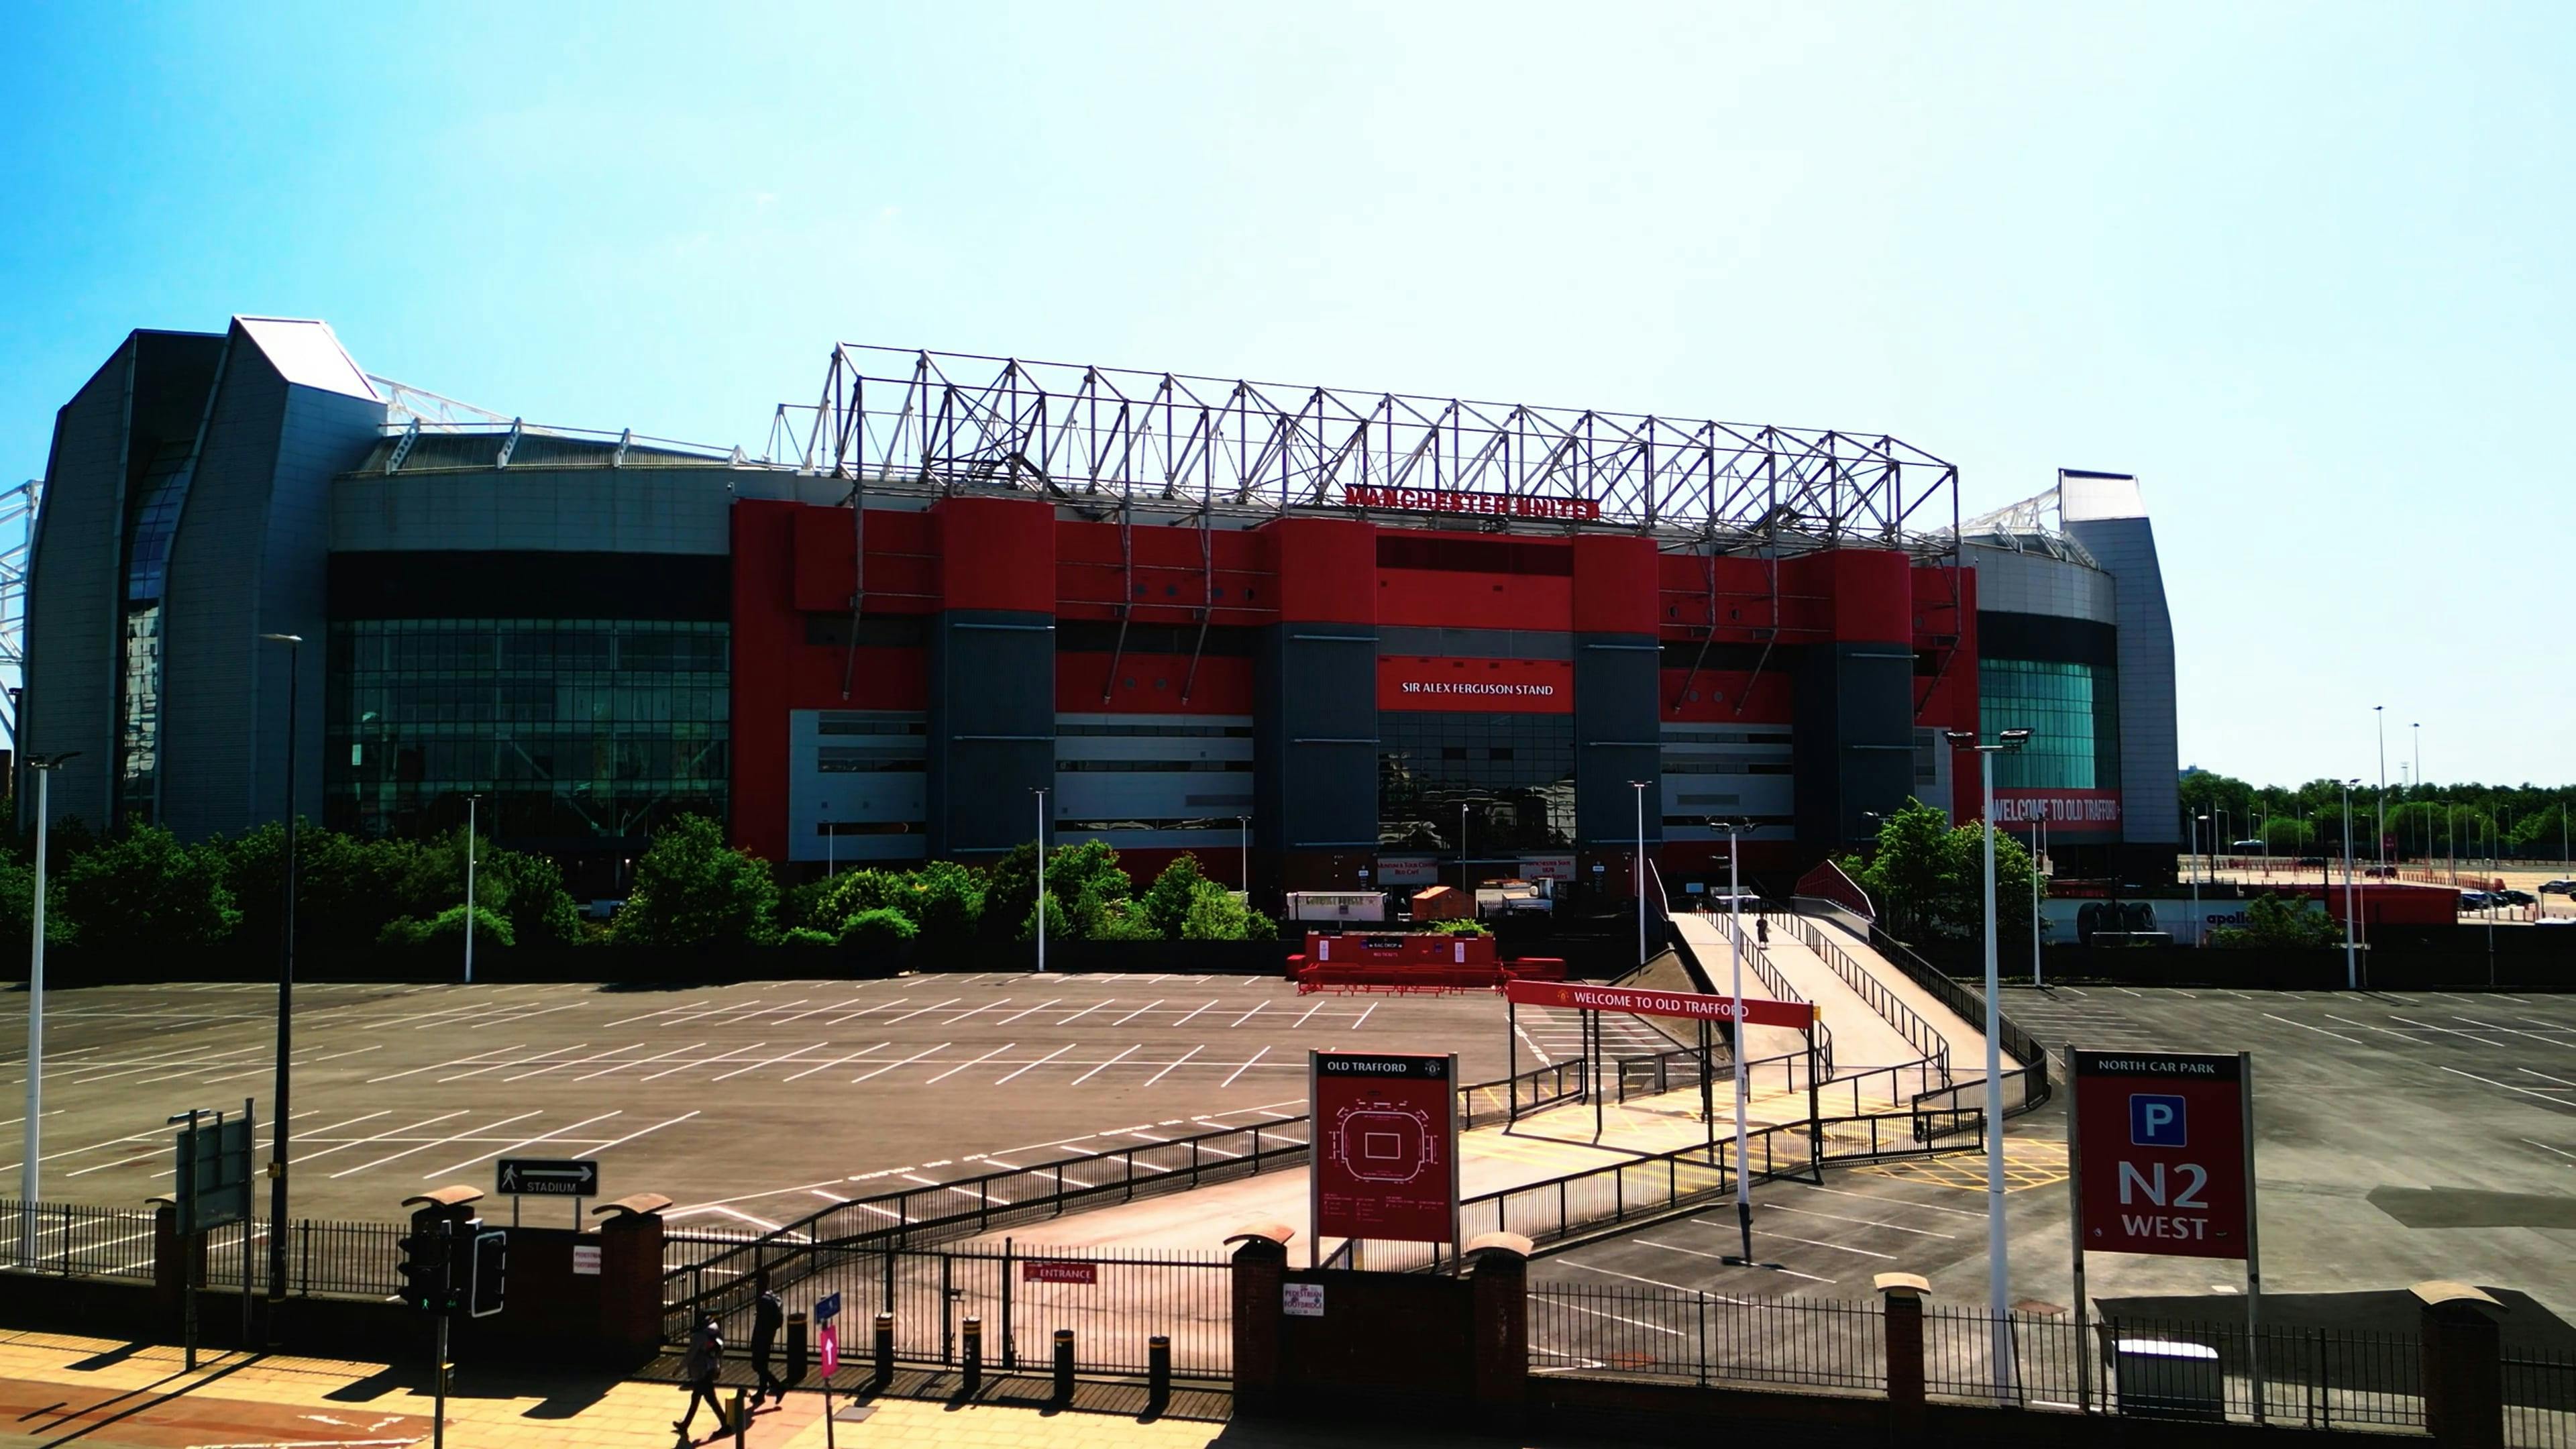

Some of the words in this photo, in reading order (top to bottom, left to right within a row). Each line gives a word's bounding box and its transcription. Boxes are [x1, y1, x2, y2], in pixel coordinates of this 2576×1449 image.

[1346, 486, 1508, 515] MANCHESTER
[1516, 497, 1601, 521] UNITED
[1402, 682, 1420, 693] SIR
[1423, 682, 1450, 693] ALEX
[1453, 684, 1513, 695] FERGUSON
[1516, 685, 1554, 695] STAND
[1993, 798, 2048, 822] WELCOME
[2051, 799, 2063, 821] TO
[2066, 800, 2083, 821] OLD
[2084, 800, 2116, 820] TRAFFORD
[1574, 991, 1631, 1007] WELCOME
[1635, 997, 1652, 1008] TO
[1656, 998, 1680, 1011] OLD
[1328, 1061, 1349, 1071] OLD
[1352, 1062, 1407, 1072] TRAFFORD
[2099, 1060, 2145, 1071] NORTH
[2149, 1062, 2176, 1072] CAR
[2180, 1063, 2215, 1073] PARK
[2146, 1104, 2174, 1136] P
[527, 1181, 576, 1193] STADIUM
[2118, 1161, 2208, 1208] N2
[2121, 1214, 2208, 1240] WEST
[1040, 1269, 1091, 1279] ENTRANCE
